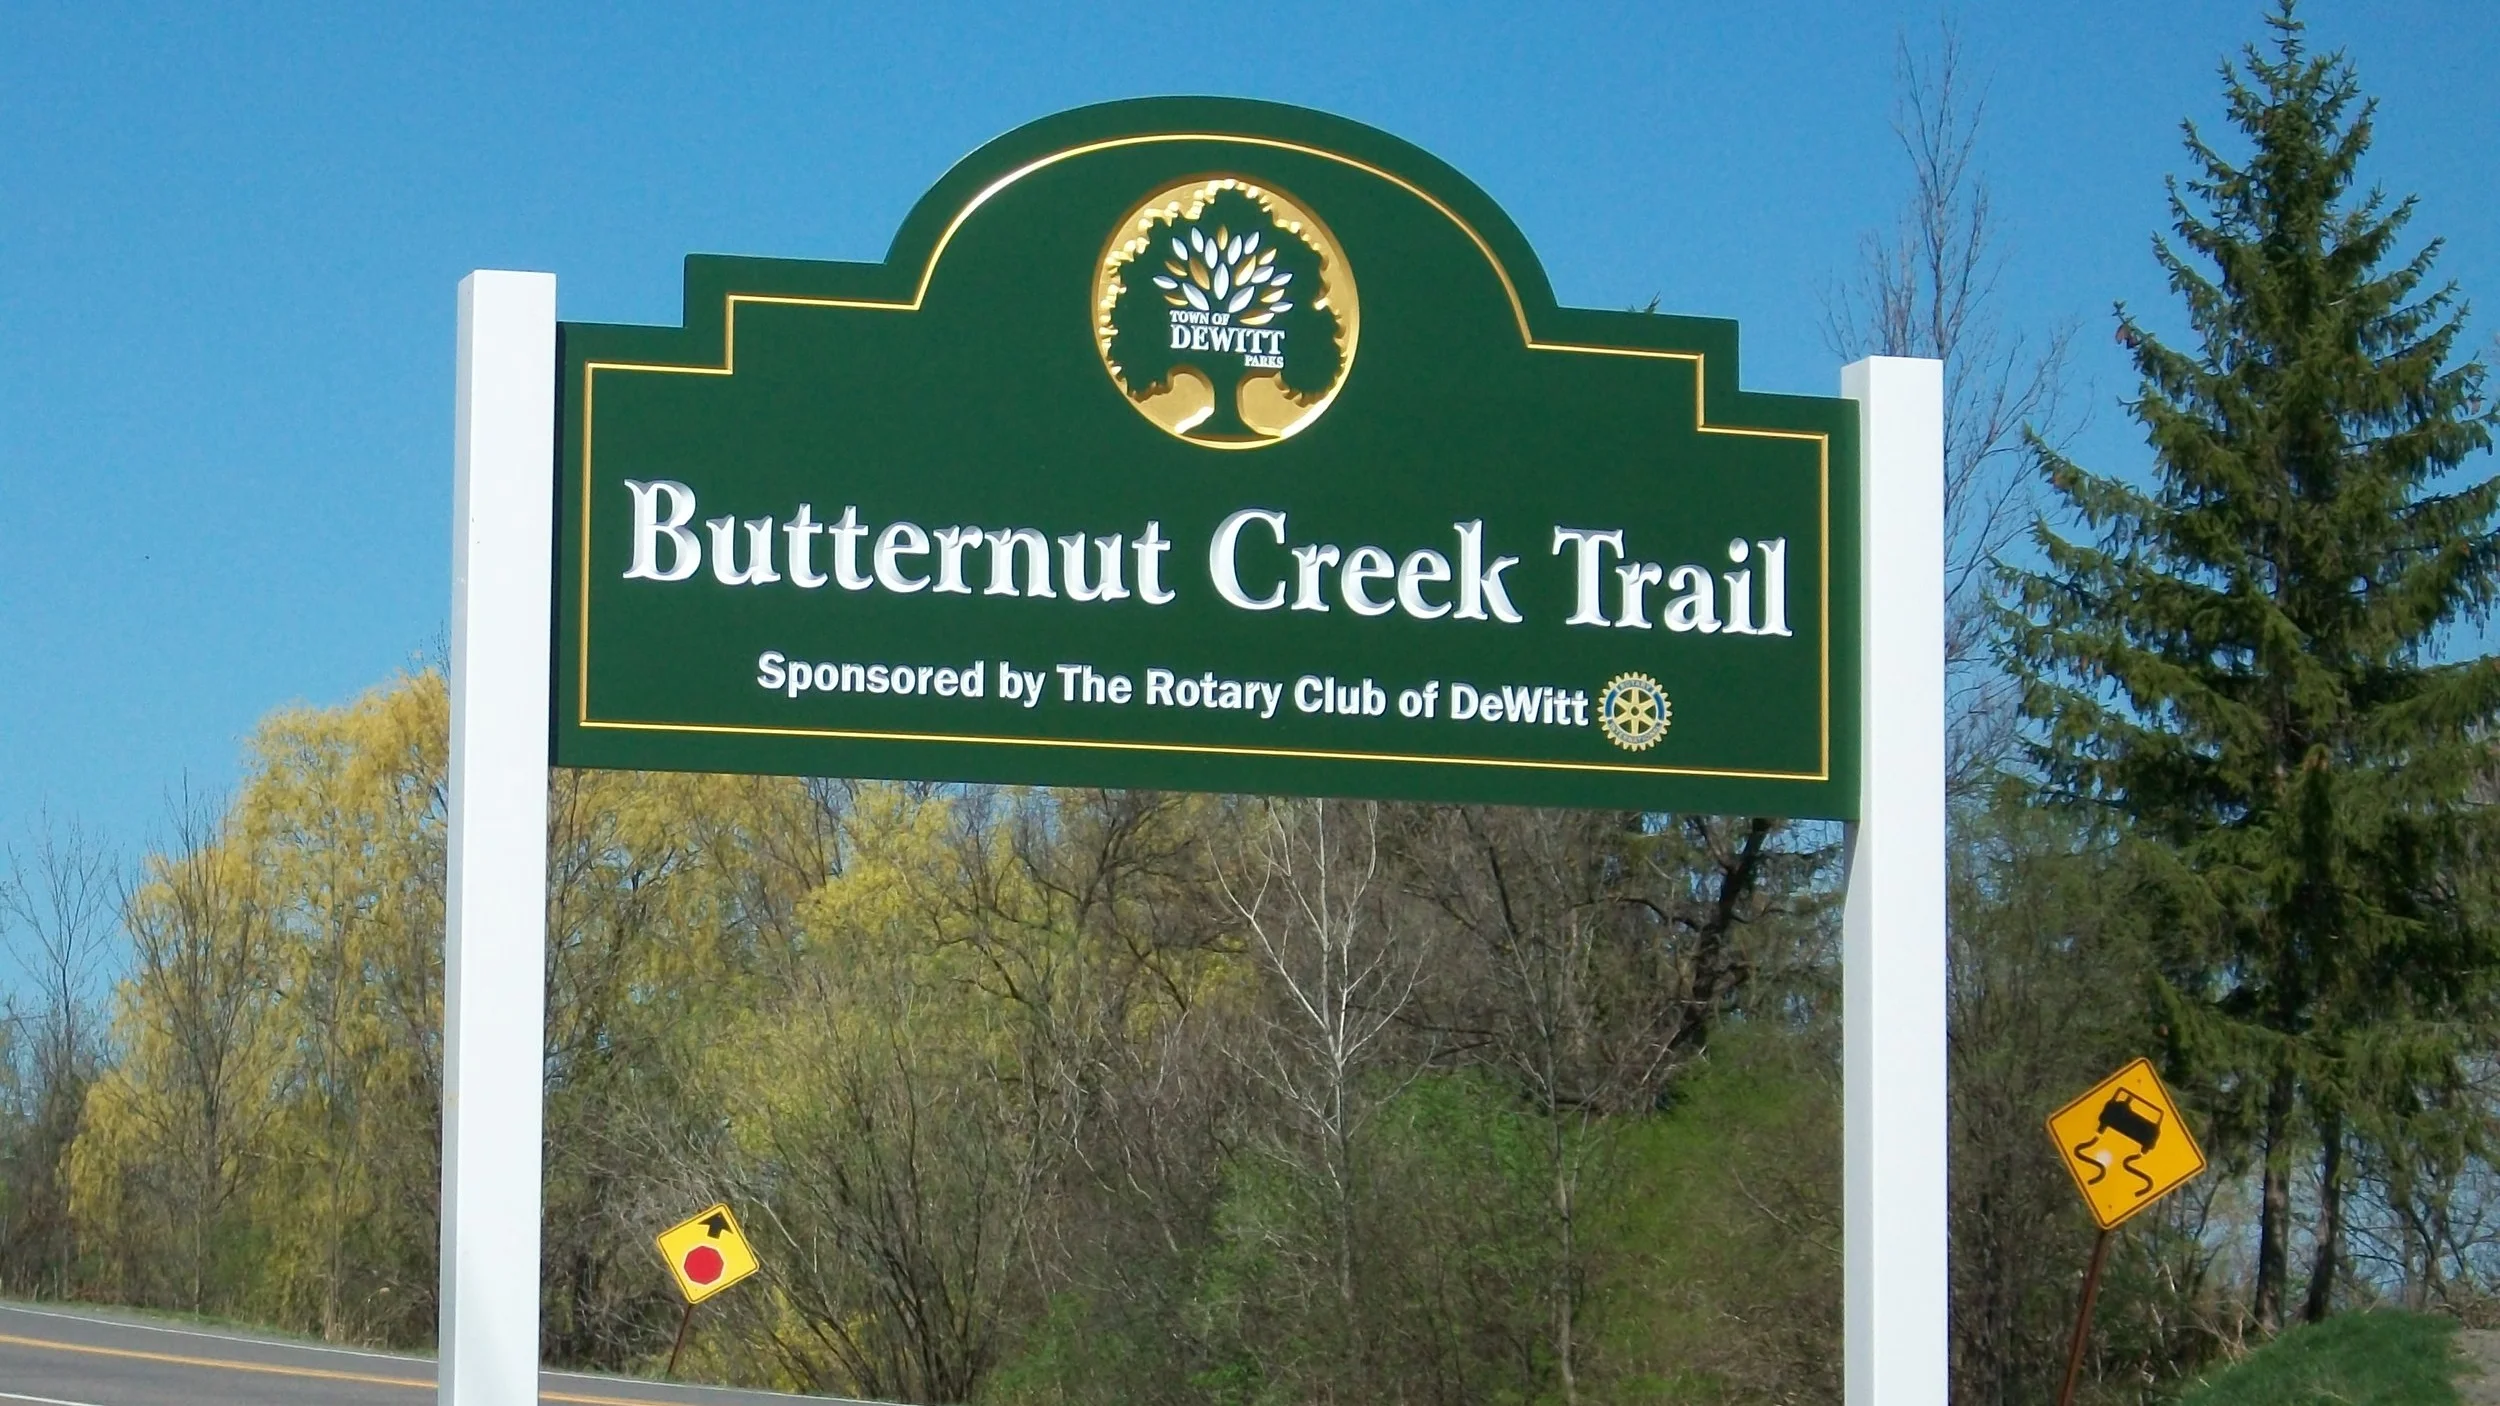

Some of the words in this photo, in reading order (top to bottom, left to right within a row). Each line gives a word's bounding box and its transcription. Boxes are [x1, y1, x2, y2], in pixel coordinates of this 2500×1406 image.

[1169, 309, 1210, 325] TOWN
[1211, 313, 1231, 326] OF
[1170, 323, 1285, 355] DEWITT
[1244, 354, 1284, 369] PARKS
[622, 479, 1176, 605] Butternut
[1209, 509, 1523, 624] Creek
[1552, 526, 1793, 637] Trail
[757, 651, 984, 698] Sponsored
[999, 661, 1046, 708] by
[1056, 664, 1133, 704] The
[1146, 668, 1283, 719] Rotary
[1294, 677, 1386, 716] Club
[1398, 680, 1439, 718] of
[1450, 683, 1589, 726] DeWitt
